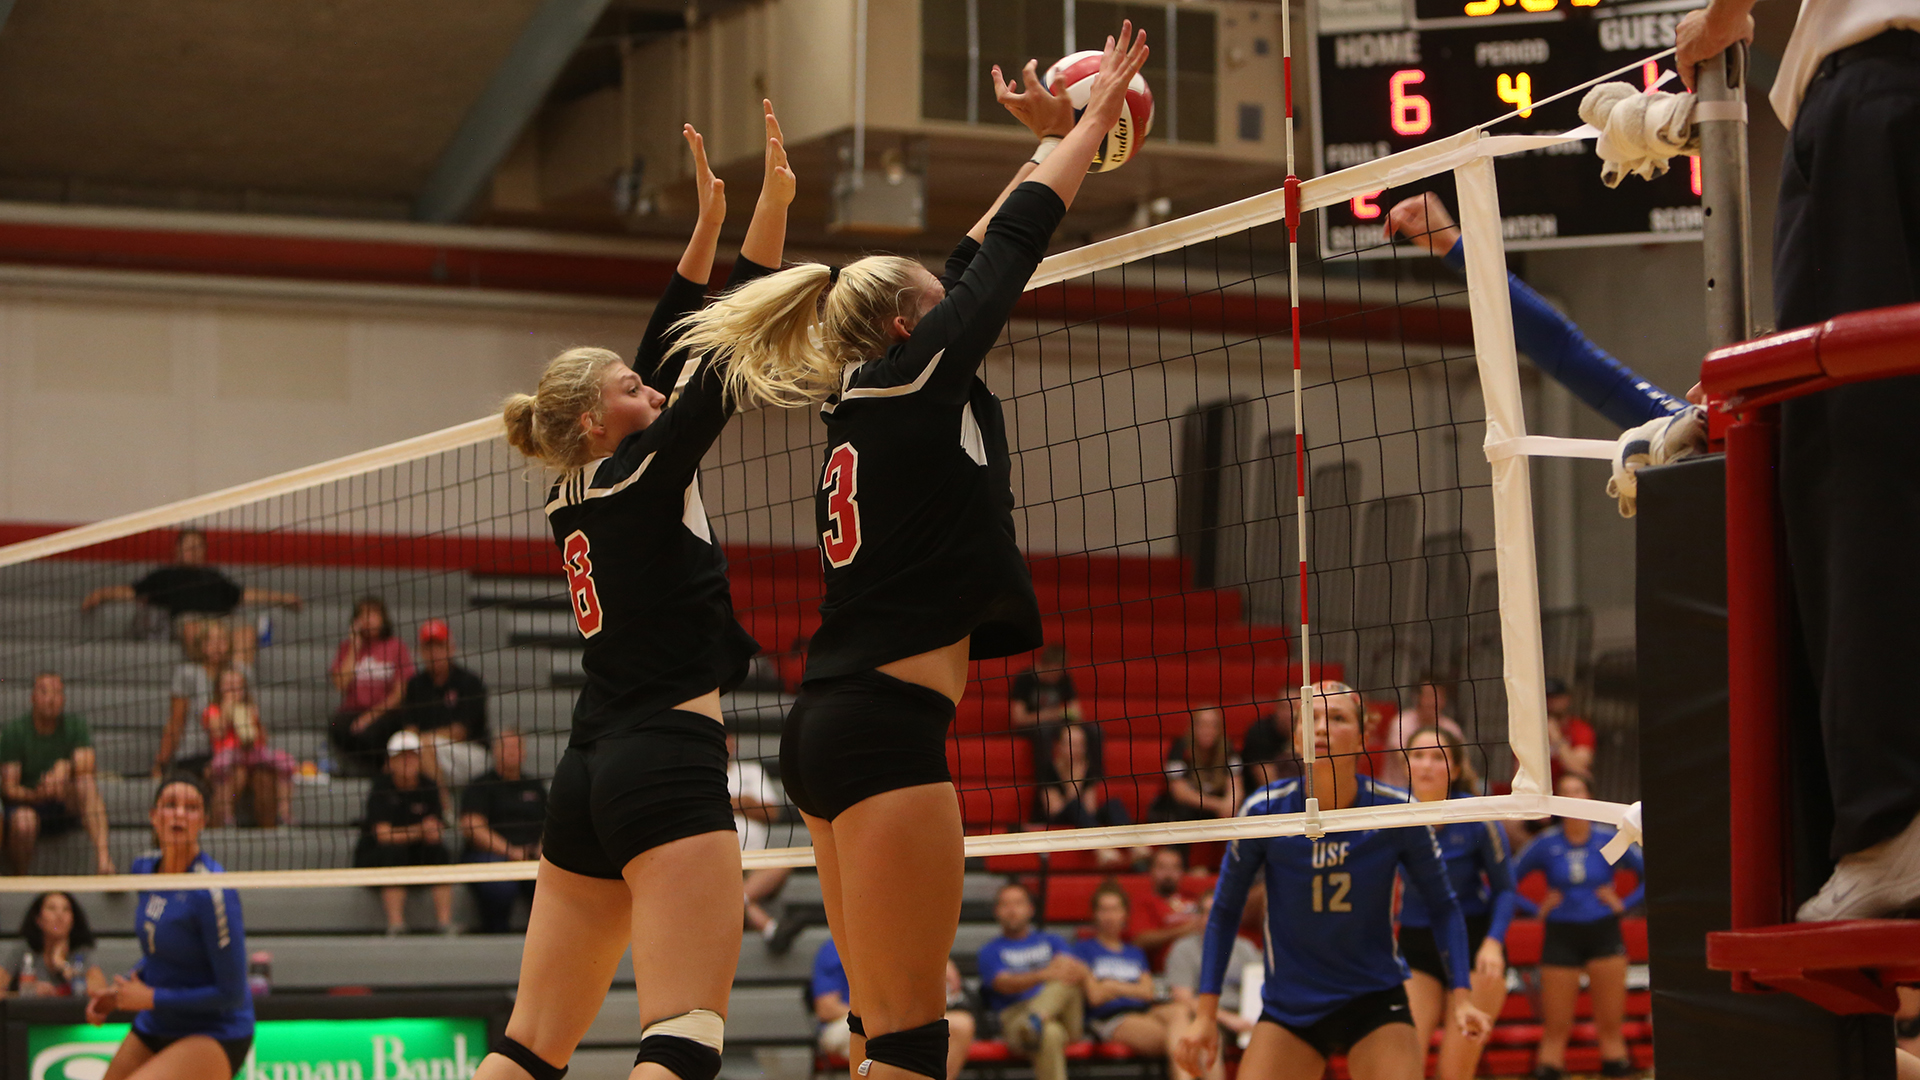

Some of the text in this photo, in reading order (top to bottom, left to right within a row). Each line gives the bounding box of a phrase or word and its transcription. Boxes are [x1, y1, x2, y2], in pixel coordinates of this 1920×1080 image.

[1335, 31, 1422, 68] HOME
[1476, 38, 1549, 67] PERIOD
[1600, 13, 1684, 51] GUES
[1389, 69, 1432, 136] 6
[1497, 72, 1532, 119] 4
[818, 441, 862, 569] 3
[562, 529, 603, 640] 8
[1312, 841, 1350, 869] USF
[1312, 872, 1352, 912] 12
[370, 1033, 483, 1080] Bank
